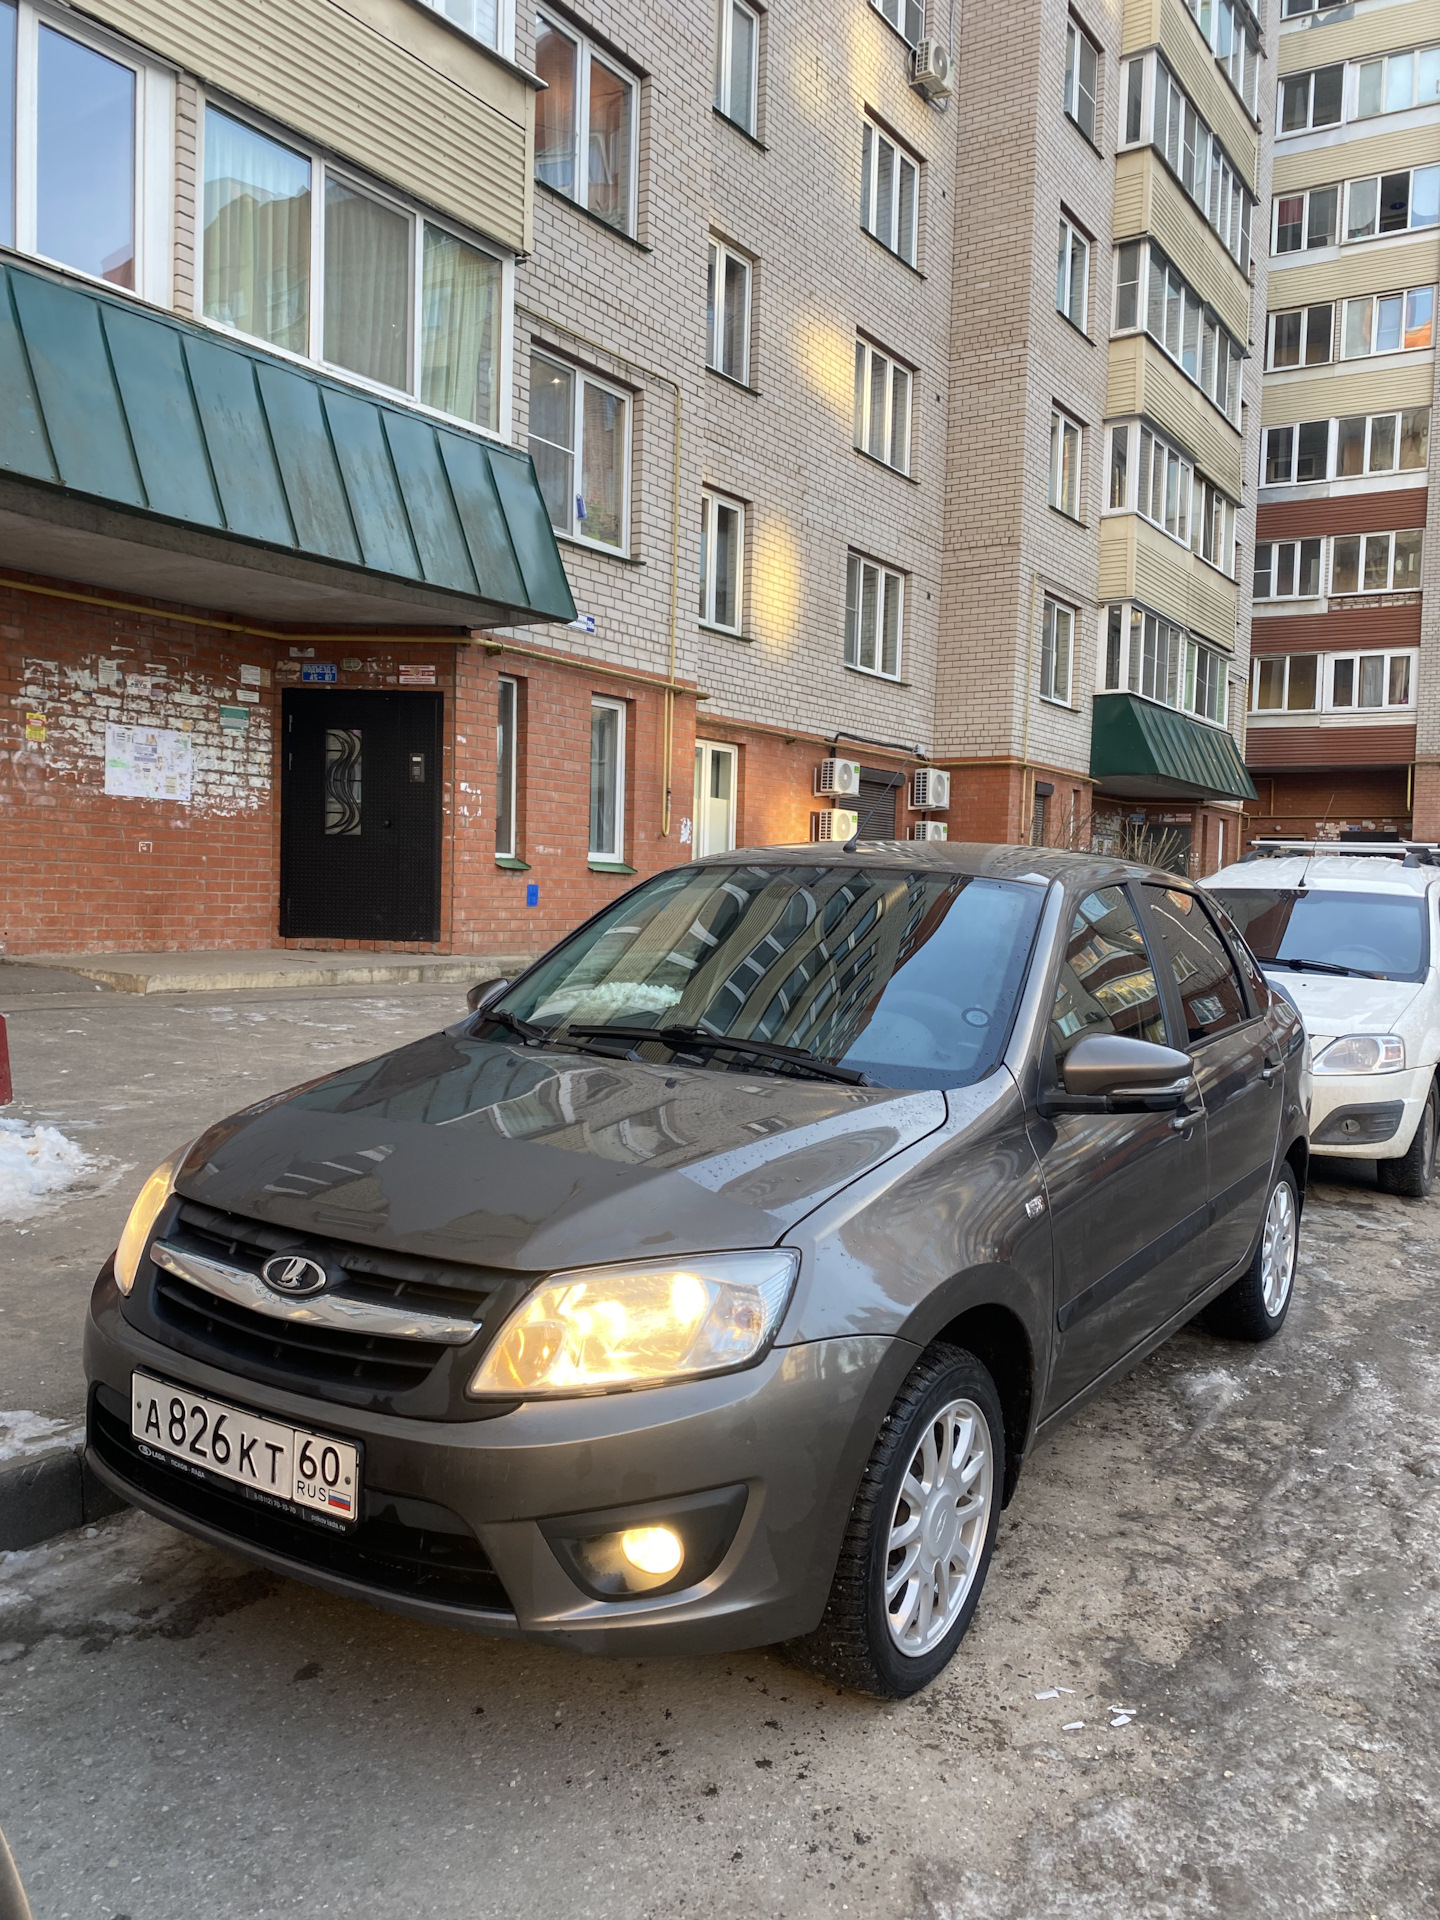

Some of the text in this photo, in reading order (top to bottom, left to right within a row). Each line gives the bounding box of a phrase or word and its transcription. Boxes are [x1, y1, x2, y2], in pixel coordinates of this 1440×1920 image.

[303, 665, 331, 673] ПОДЪЕЗД
[145, 1397, 284, 1484] А826КТ
[152, 1451, 166, 1462] LADA
[299, 1440, 341, 1487] 60
[296, 1480, 327, 1503] RUS
